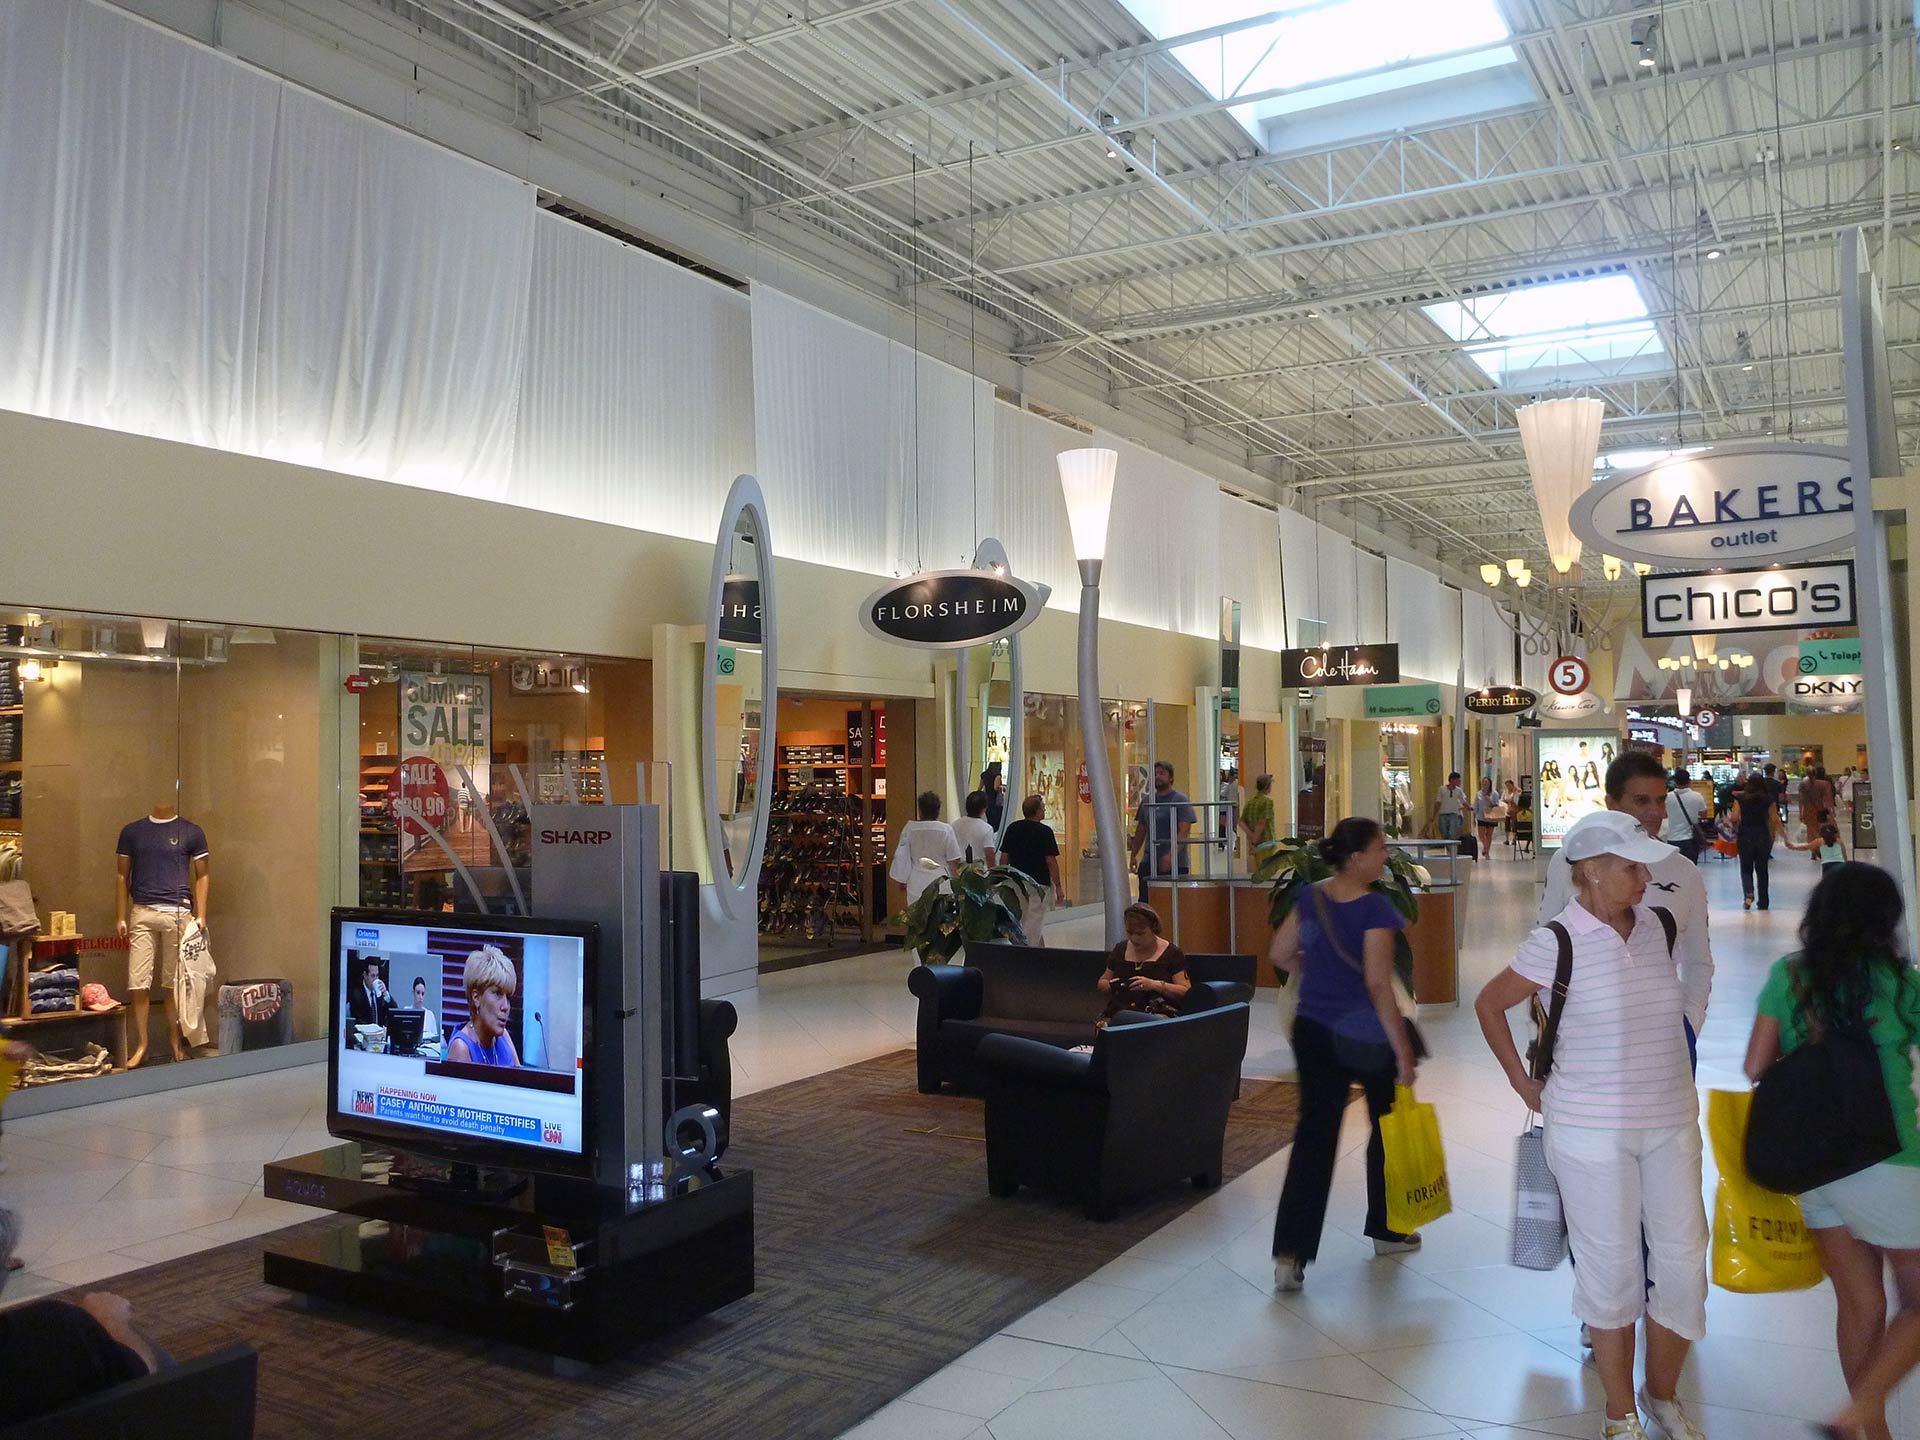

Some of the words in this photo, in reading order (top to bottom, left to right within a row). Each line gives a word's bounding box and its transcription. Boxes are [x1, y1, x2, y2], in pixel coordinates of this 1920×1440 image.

[1630, 476, 1854, 530] BAKERS
[1710, 529, 1778, 548] outlet
[878, 597, 1019, 621] FLORSHEIM
[1654, 580, 1841, 622] chico's
[1300, 653, 1337, 679] Cole
[1561, 665, 1577, 687] 5
[406, 681, 485, 706] SUMMER
[1794, 681, 1862, 695] DKNY
[1468, 696, 1501, 707] PERRY
[1502, 694, 1532, 706] ELLIS
[406, 705, 485, 747] SALE
[1701, 712, 1710, 724] 5
[401, 763, 437, 785] SALE
[1860, 813, 1873, 830] 5
[540, 830, 612, 845] SHARP
[356, 1090, 374, 1104] NEWS
[379, 1086, 419, 1100] HAPPENING
[420, 1092, 437, 1102] NOW
[355, 1101, 375, 1115] ROOM
[380, 1096, 407, 1109] CASEY
[408, 1101, 456, 1117] ANTHONY'S
[457, 1108, 492, 1123] MOTHER
[494, 1114, 536, 1130] TESTIFIES
[380, 1106, 403, 1117] Parents
[421, 1113, 432, 1121] her
[433, 1115, 440, 1123] to
[441, 1117, 459, 1127] avoid
[461, 1120, 479, 1129] death
[480, 1124, 506, 1135] penalty
[544, 1121, 562, 1131] LIVE
[543, 1129, 562, 1145] CNN
